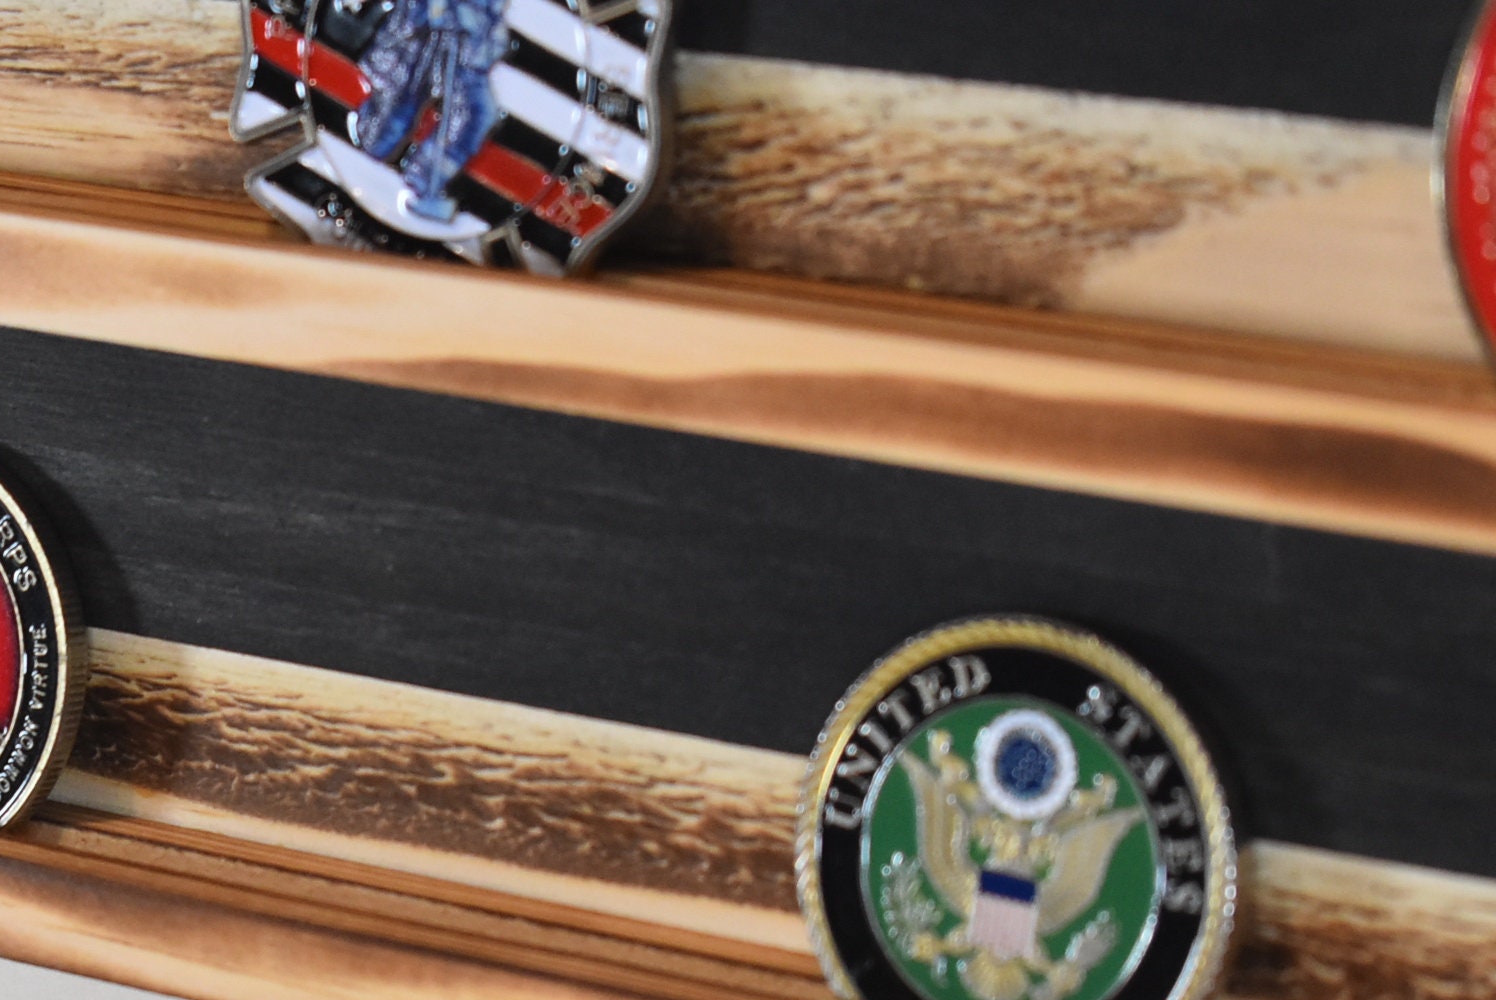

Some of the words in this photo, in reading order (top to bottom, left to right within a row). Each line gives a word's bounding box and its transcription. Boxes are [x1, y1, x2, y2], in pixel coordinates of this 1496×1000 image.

[28, 623, 49, 710] VIRTUE
[824, 653, 992, 829] UNITED
[1077, 684, 1204, 915] STATES
